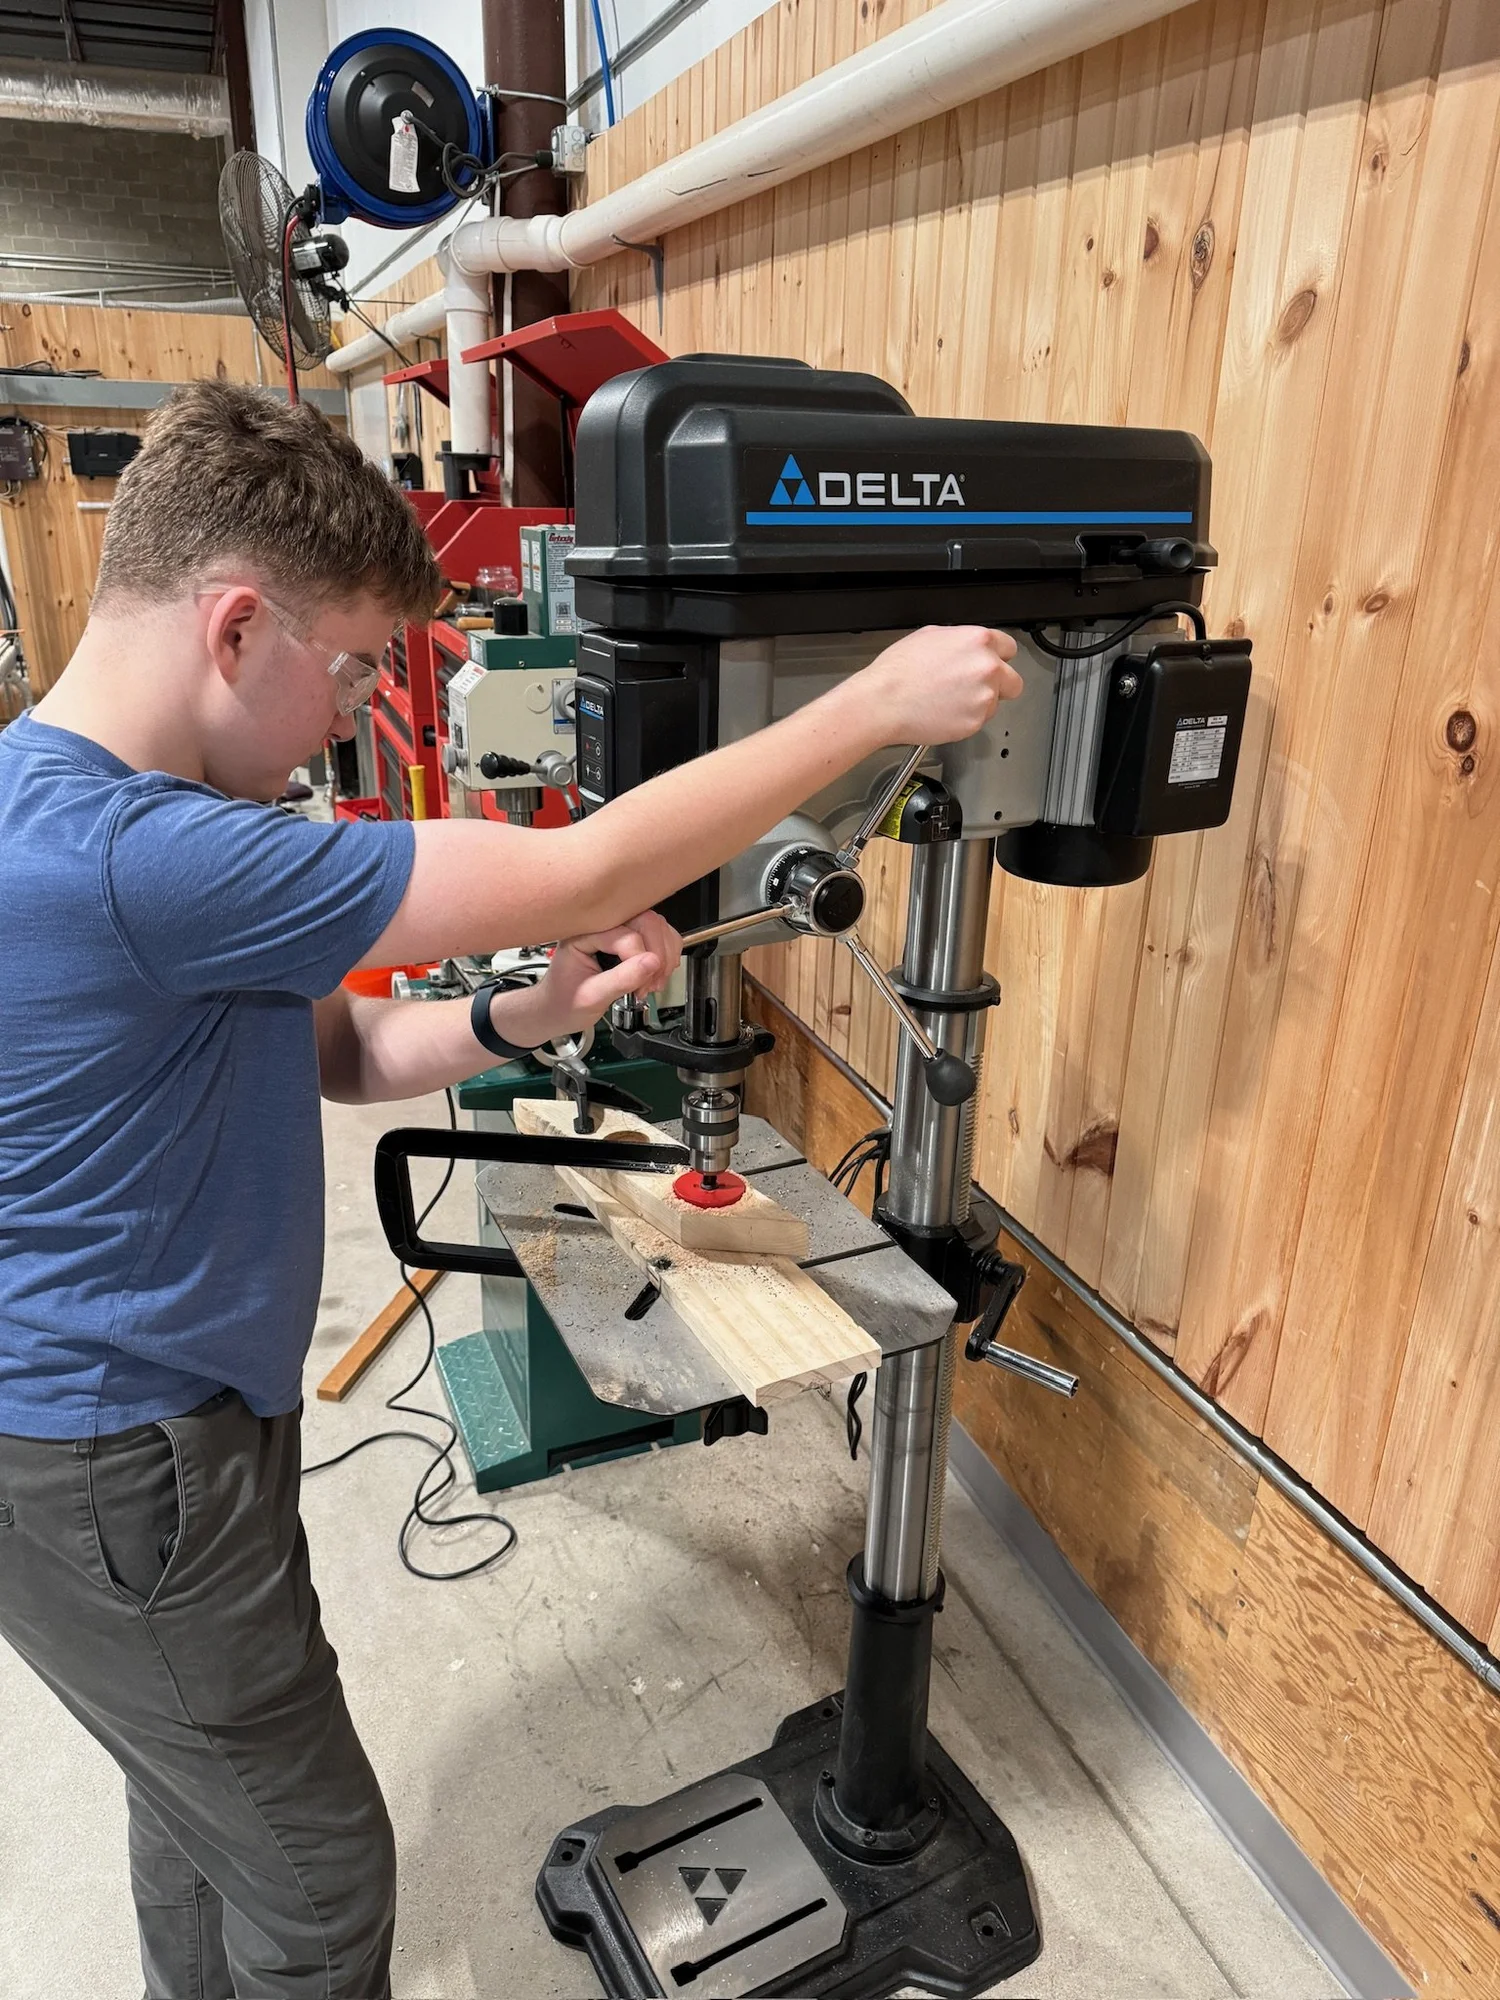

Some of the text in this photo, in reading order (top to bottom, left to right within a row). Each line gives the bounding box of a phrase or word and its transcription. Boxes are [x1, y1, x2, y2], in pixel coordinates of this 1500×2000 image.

[818, 472, 966, 506] DELTA
[585, 700, 604, 717] DELTA
[1182, 717, 1206, 725] DELTA
